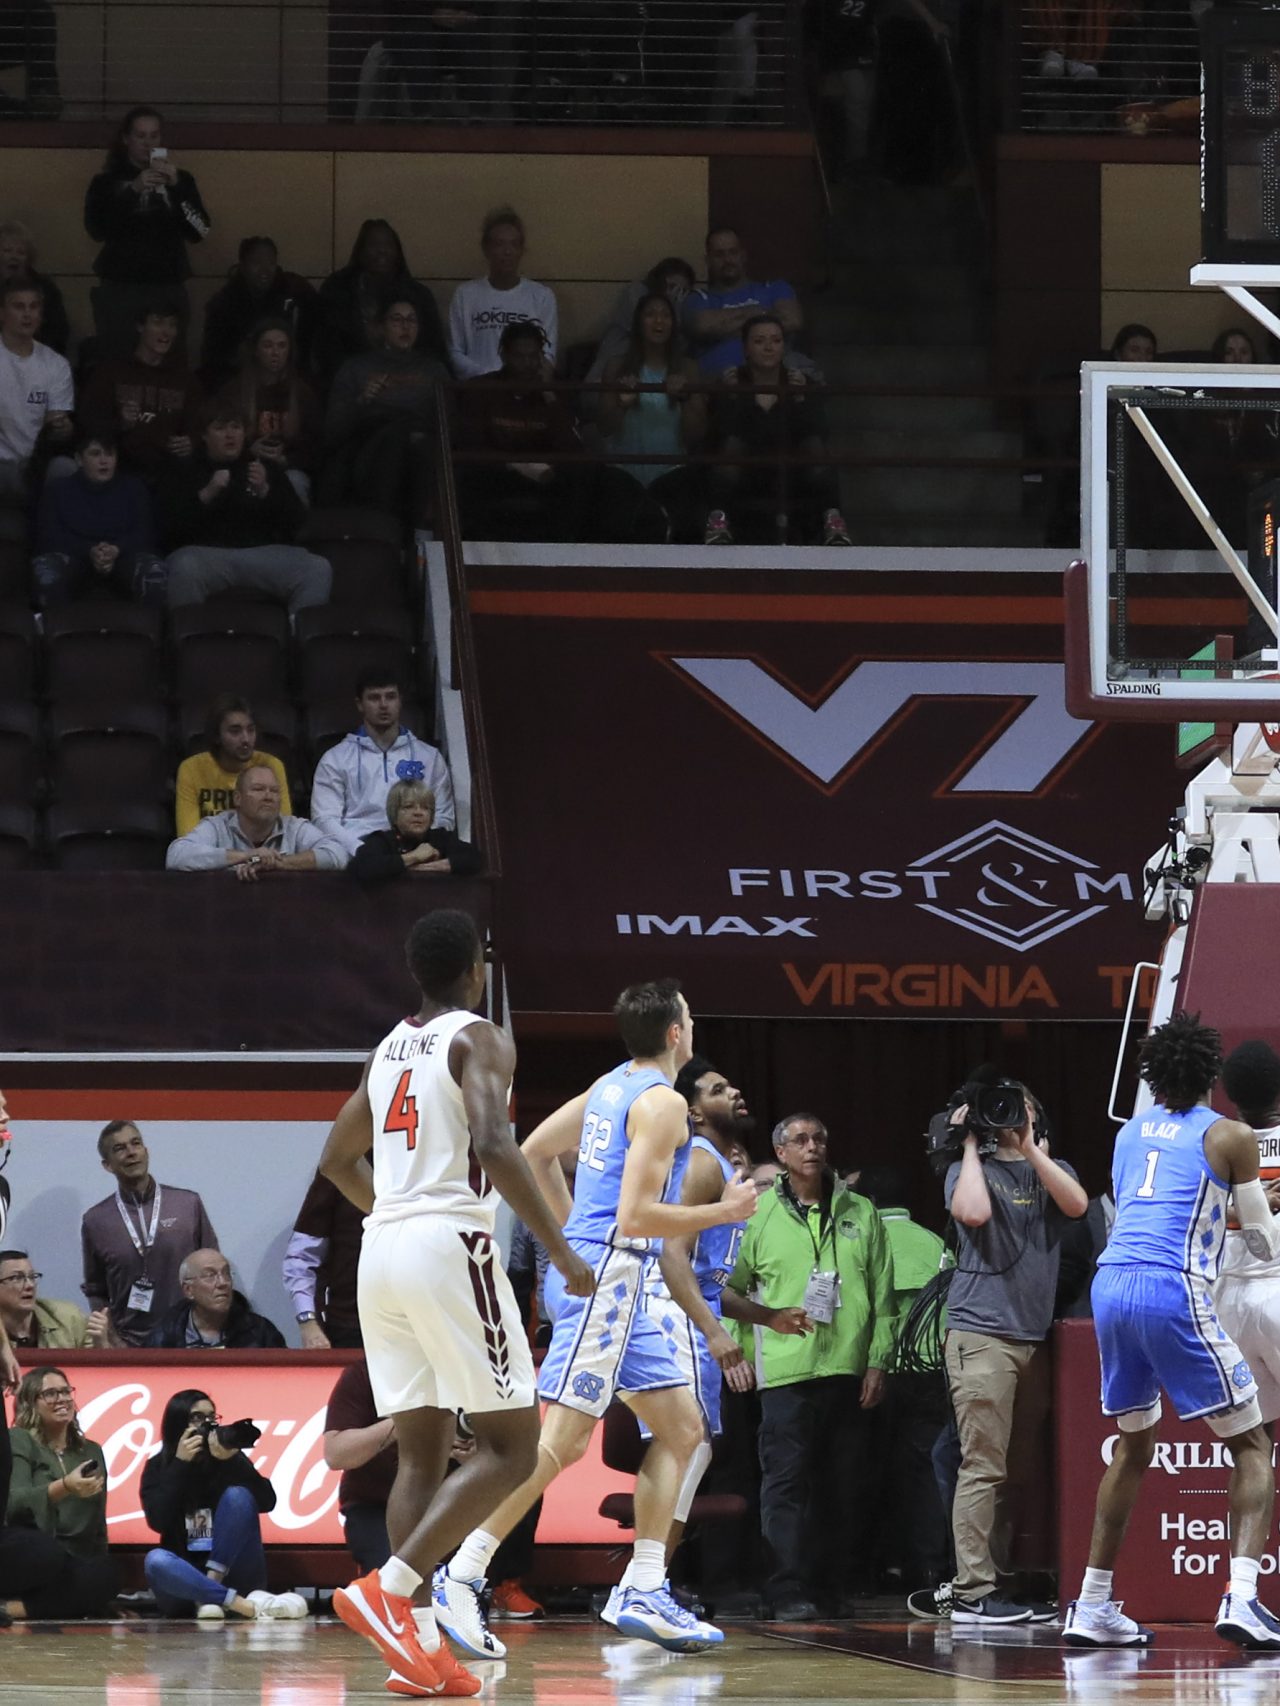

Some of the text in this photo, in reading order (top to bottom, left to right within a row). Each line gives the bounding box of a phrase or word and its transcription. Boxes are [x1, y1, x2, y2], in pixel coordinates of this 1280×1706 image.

[839, 0, 865, 17] 22
[1106, 683, 1160, 695] SPALDING
[728, 868, 950, 899] FIRST
[616, 914, 819, 938] IMAX
[781, 961, 1060, 1008] VIRGINIA
[383, 1069, 418, 1151] 4
[578, 1111, 612, 1172] 32
[1141, 1121, 1182, 1141] BLACK
[1136, 1150, 1161, 1199] 1
[1172, 1545, 1221, 1576] for
